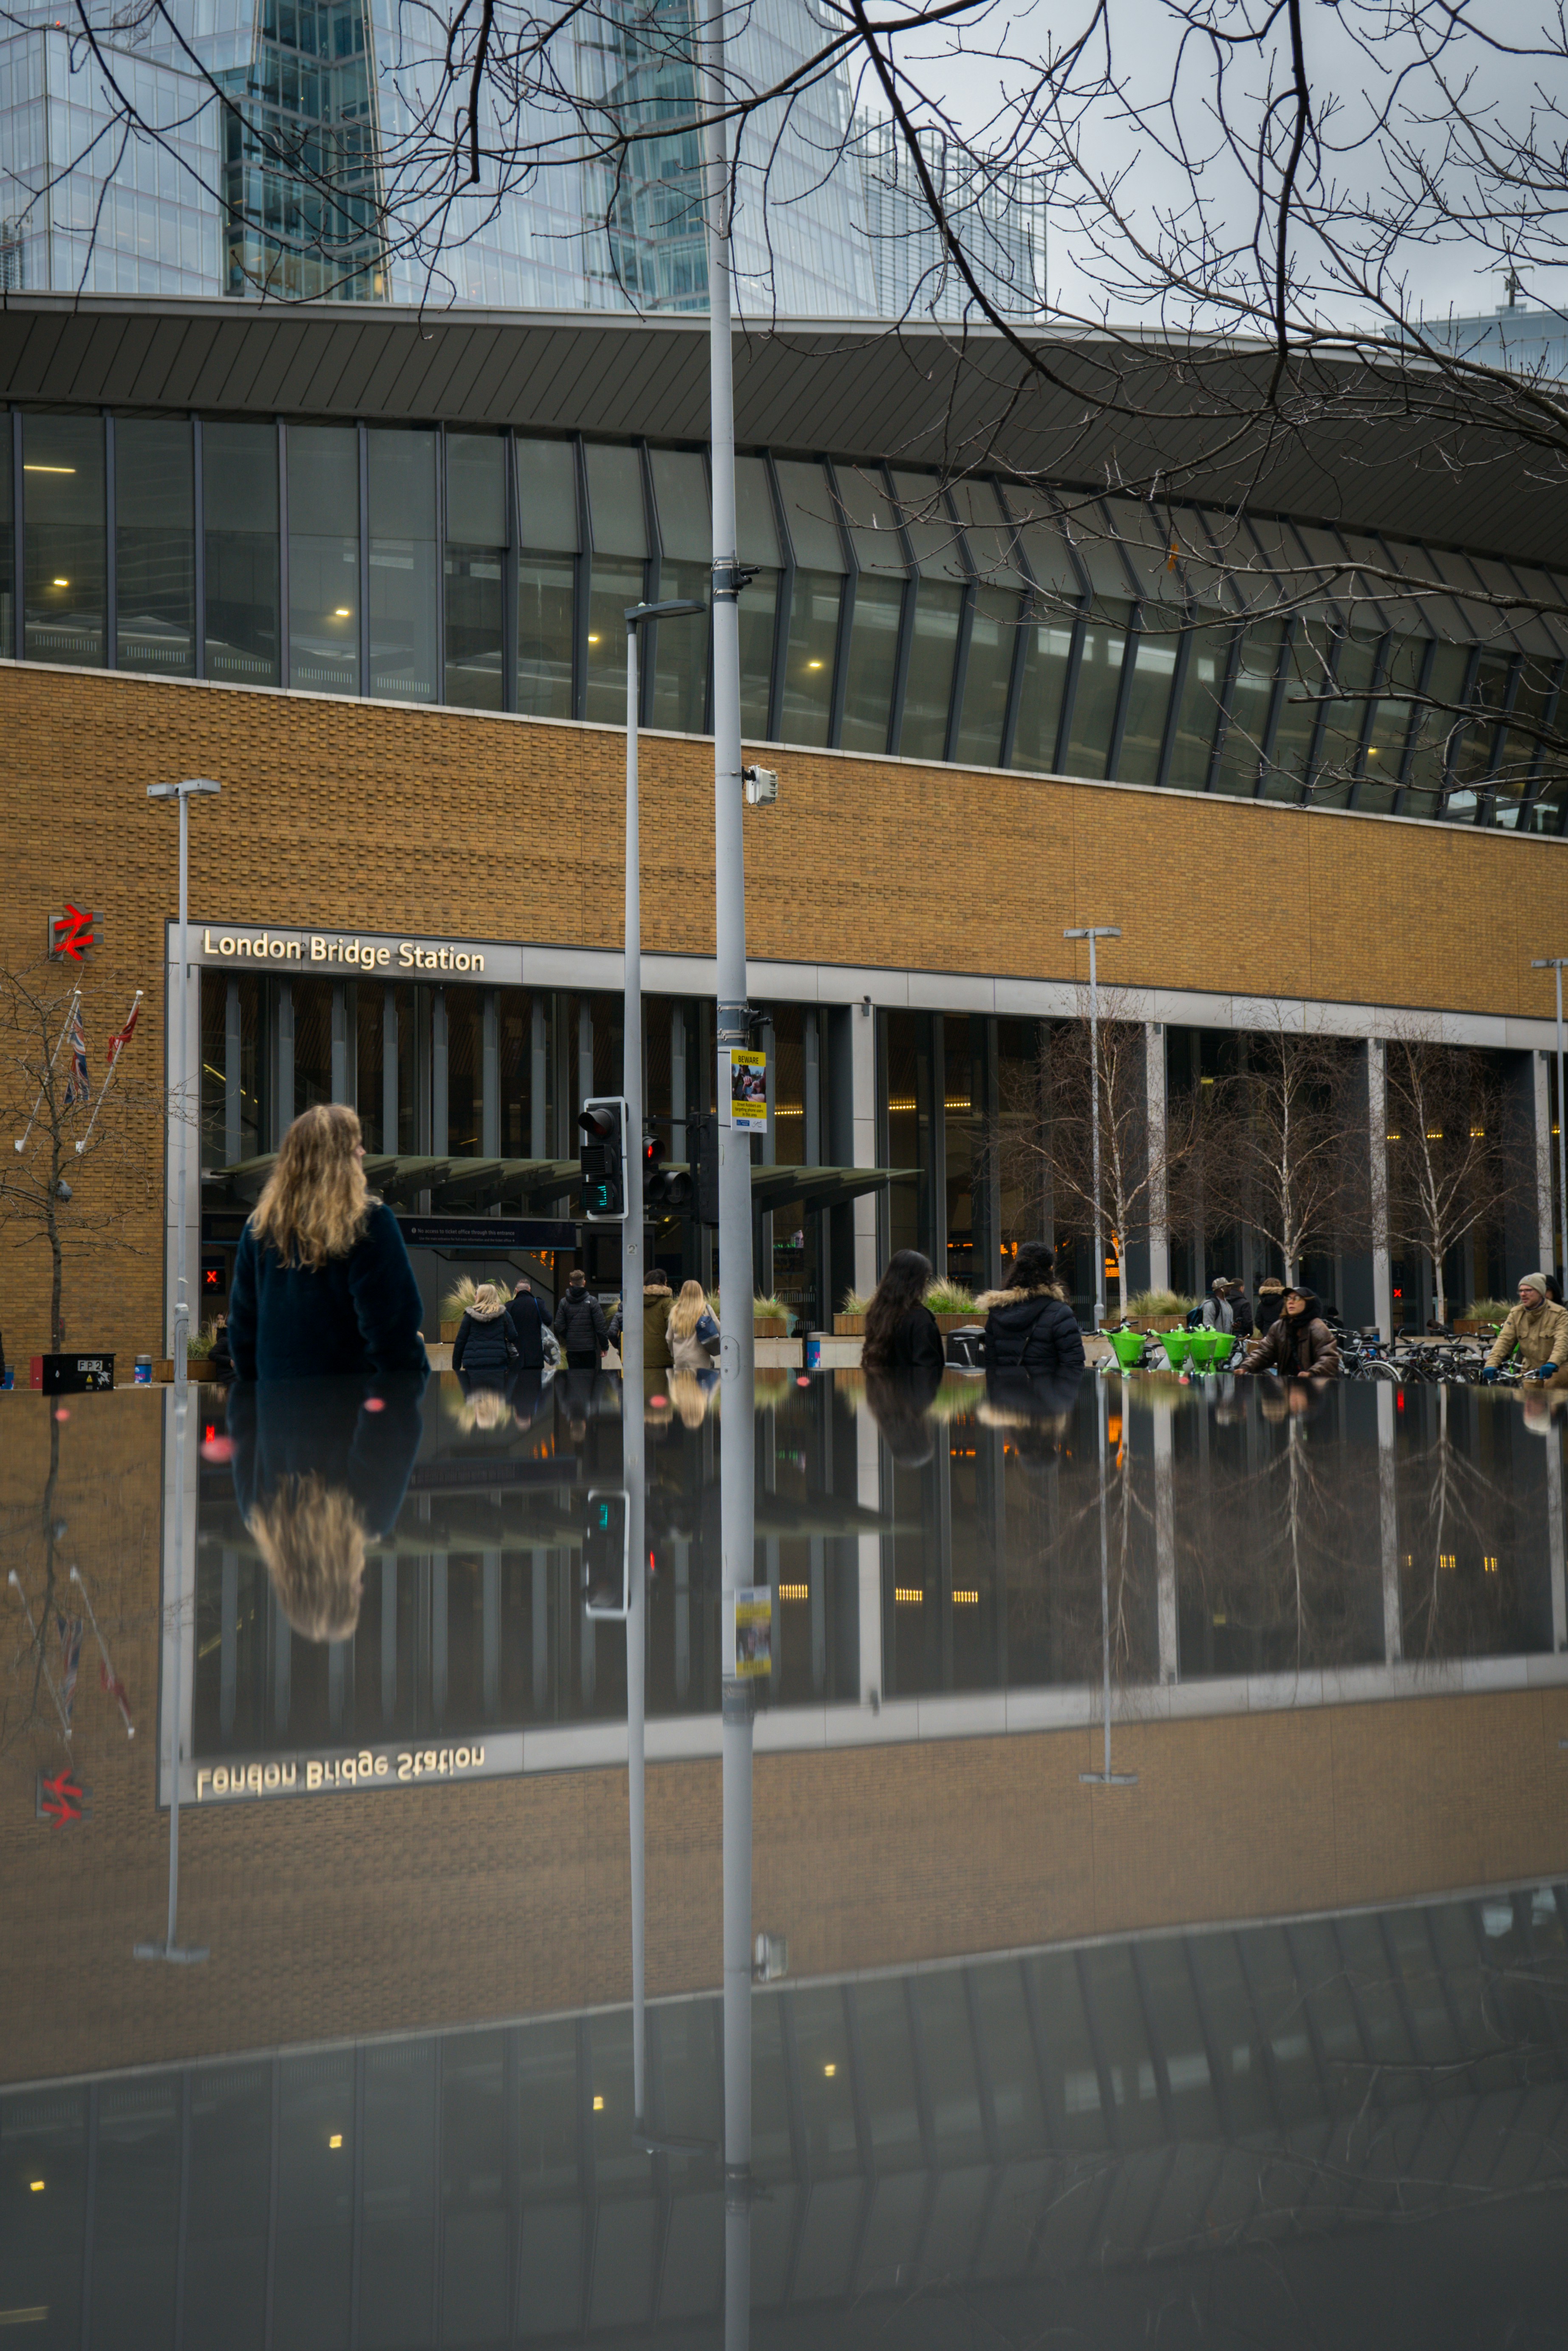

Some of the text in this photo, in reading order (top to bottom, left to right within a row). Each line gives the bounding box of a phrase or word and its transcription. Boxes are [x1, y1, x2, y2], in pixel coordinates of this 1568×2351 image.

[202, 928, 485, 972] London Bridge Station
[738, 1055, 759, 1064] BEWARE
[629, 1245, 635, 1253] 2
